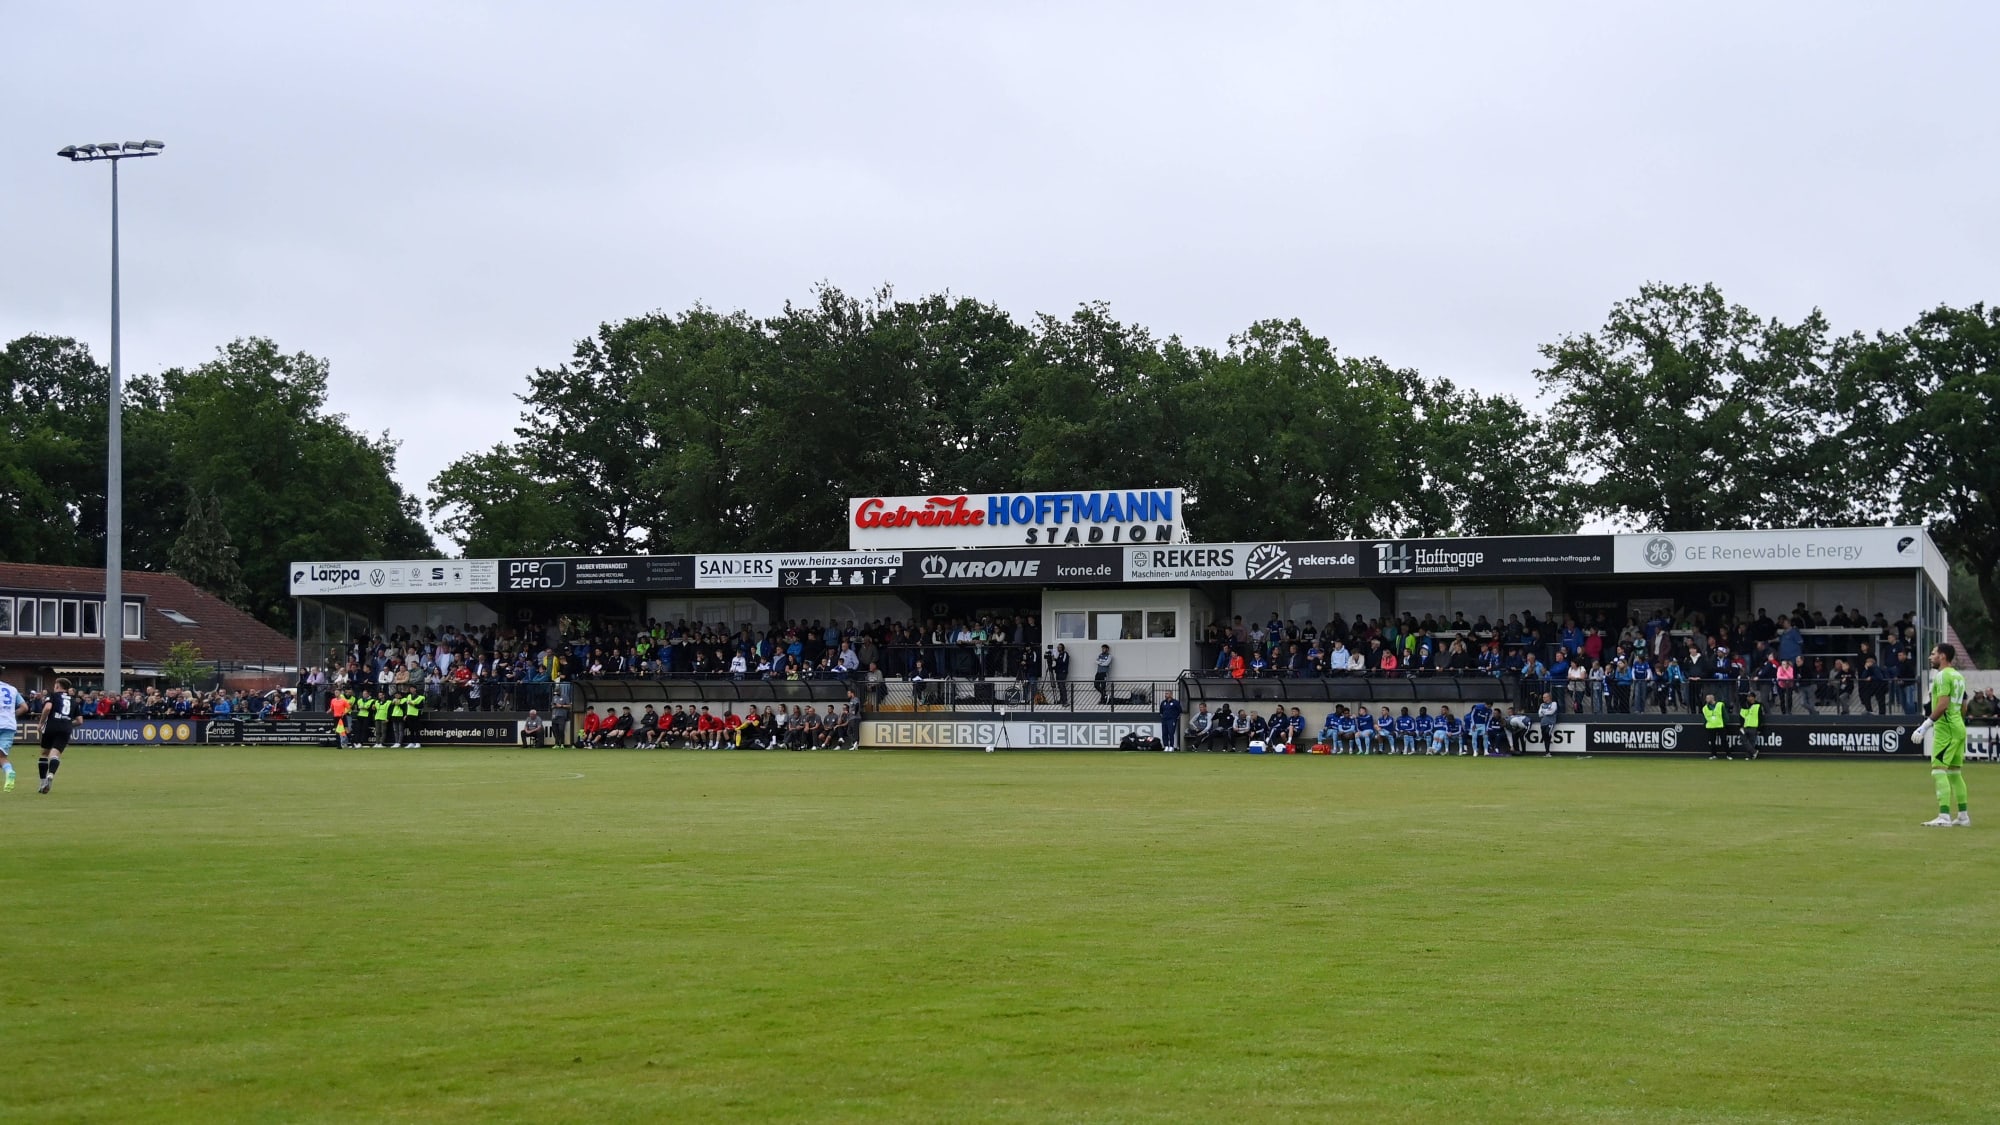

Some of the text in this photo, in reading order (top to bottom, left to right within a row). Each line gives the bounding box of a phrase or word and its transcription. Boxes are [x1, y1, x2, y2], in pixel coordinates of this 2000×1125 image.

[855, 491, 1173, 529] Getränke HOFFMANN
[1026, 525, 1173, 545] STADION
[1153, 549, 1234, 568] REKERS
[1415, 549, 1484, 568] Hoffrogge
[1502, 555, 1601, 563] www.innenausbau-hoffrogge.de
[1685, 543, 1863, 560] GE Renewable Energy
[700, 559, 773, 574] SANDERS
[781, 555, 901, 567] www.heinz-sanders.de
[1298, 553, 1355, 566] rekers.de
[311, 565, 360, 585] Lampa
[510, 562, 540, 577] pre
[949, 560, 1041, 578] KRONE
[1057, 564, 1111, 576] krone.de
[1131, 568, 1234, 579] Maschinen- und Anlagenbau
[1415, 564, 1459, 573] Innenausbau
[510, 577, 551, 589] zero
[1, 688, 13, 705] 3
[876, 723, 995, 744] REKERS
[1527, 730, 1575, 744] GST
[1593, 731, 1660, 744] SINGRAVEN
[1808, 732, 1880, 746] SINGRAVEN
